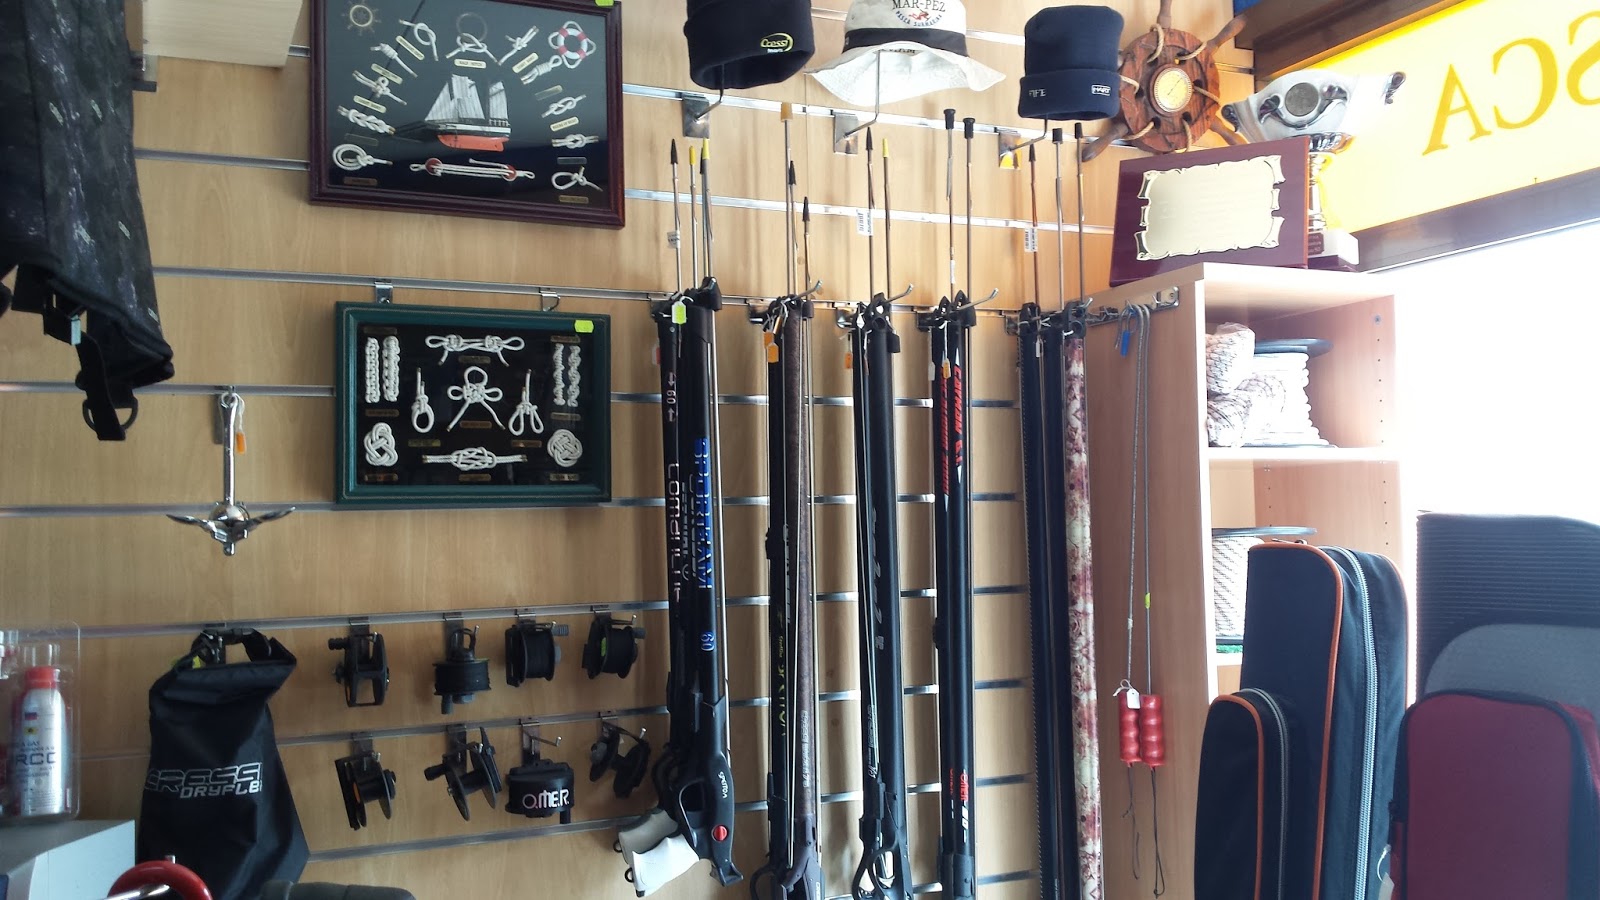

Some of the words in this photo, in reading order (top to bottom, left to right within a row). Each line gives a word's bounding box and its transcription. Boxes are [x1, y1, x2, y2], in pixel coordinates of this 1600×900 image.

[666, 389, 677, 405] 60
[700, 631, 715, 652] 60
[145, 762, 262, 793] CRESS
